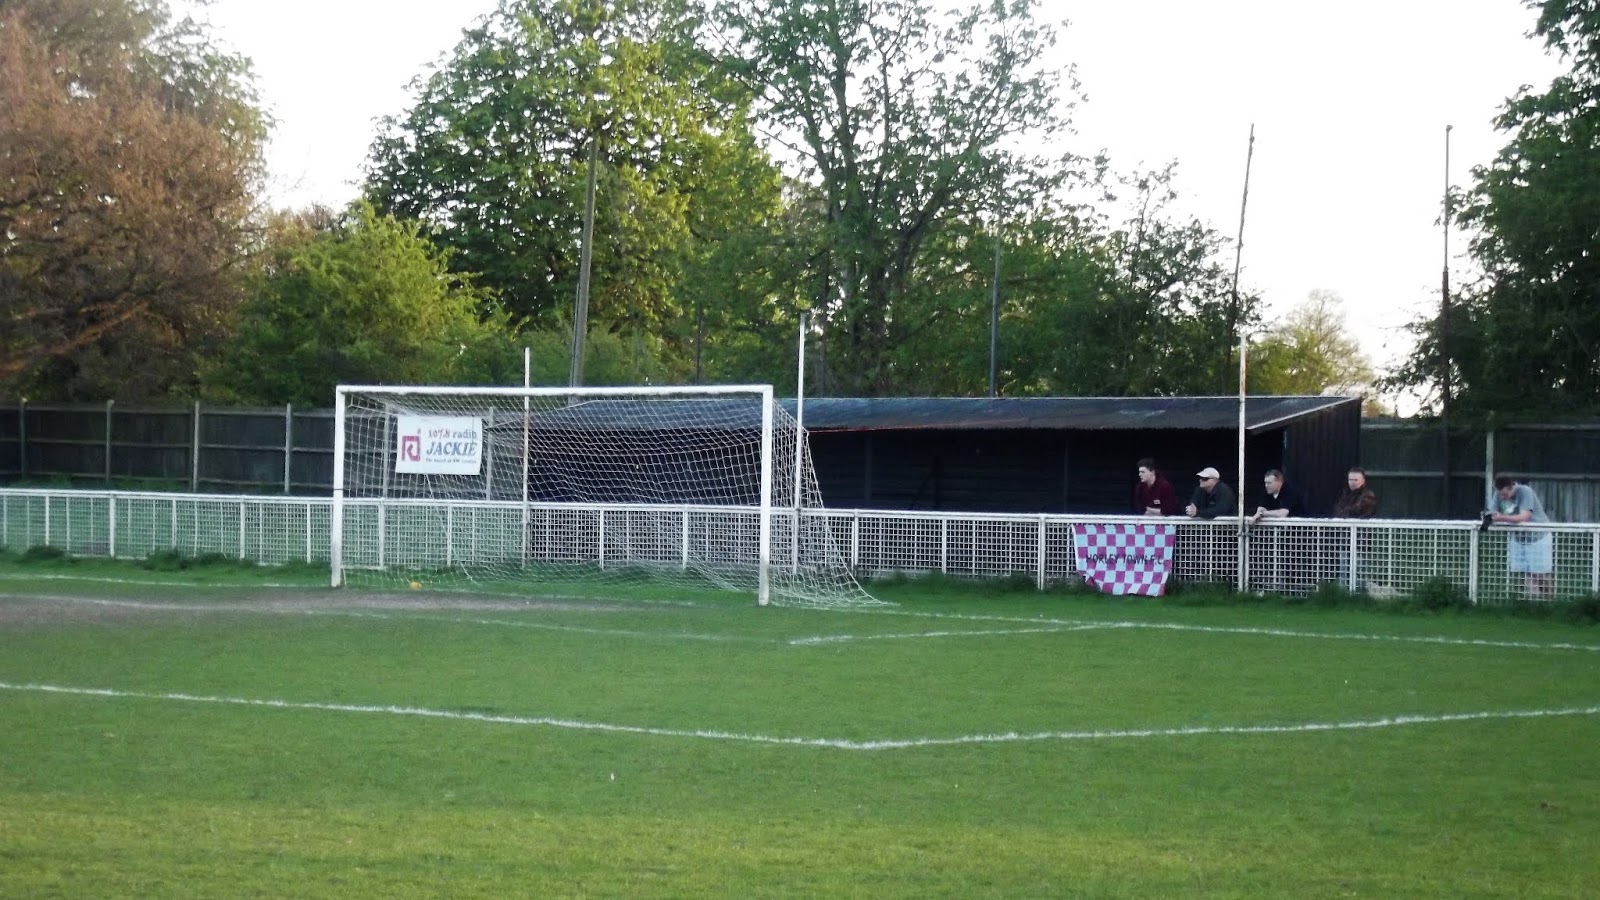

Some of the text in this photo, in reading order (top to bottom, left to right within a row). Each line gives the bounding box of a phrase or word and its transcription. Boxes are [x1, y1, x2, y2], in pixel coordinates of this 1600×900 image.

[426, 442, 478, 456] JACKIE
[1086, 553, 1118, 564] HORLEY
[1121, 554, 1147, 565] TOWN
